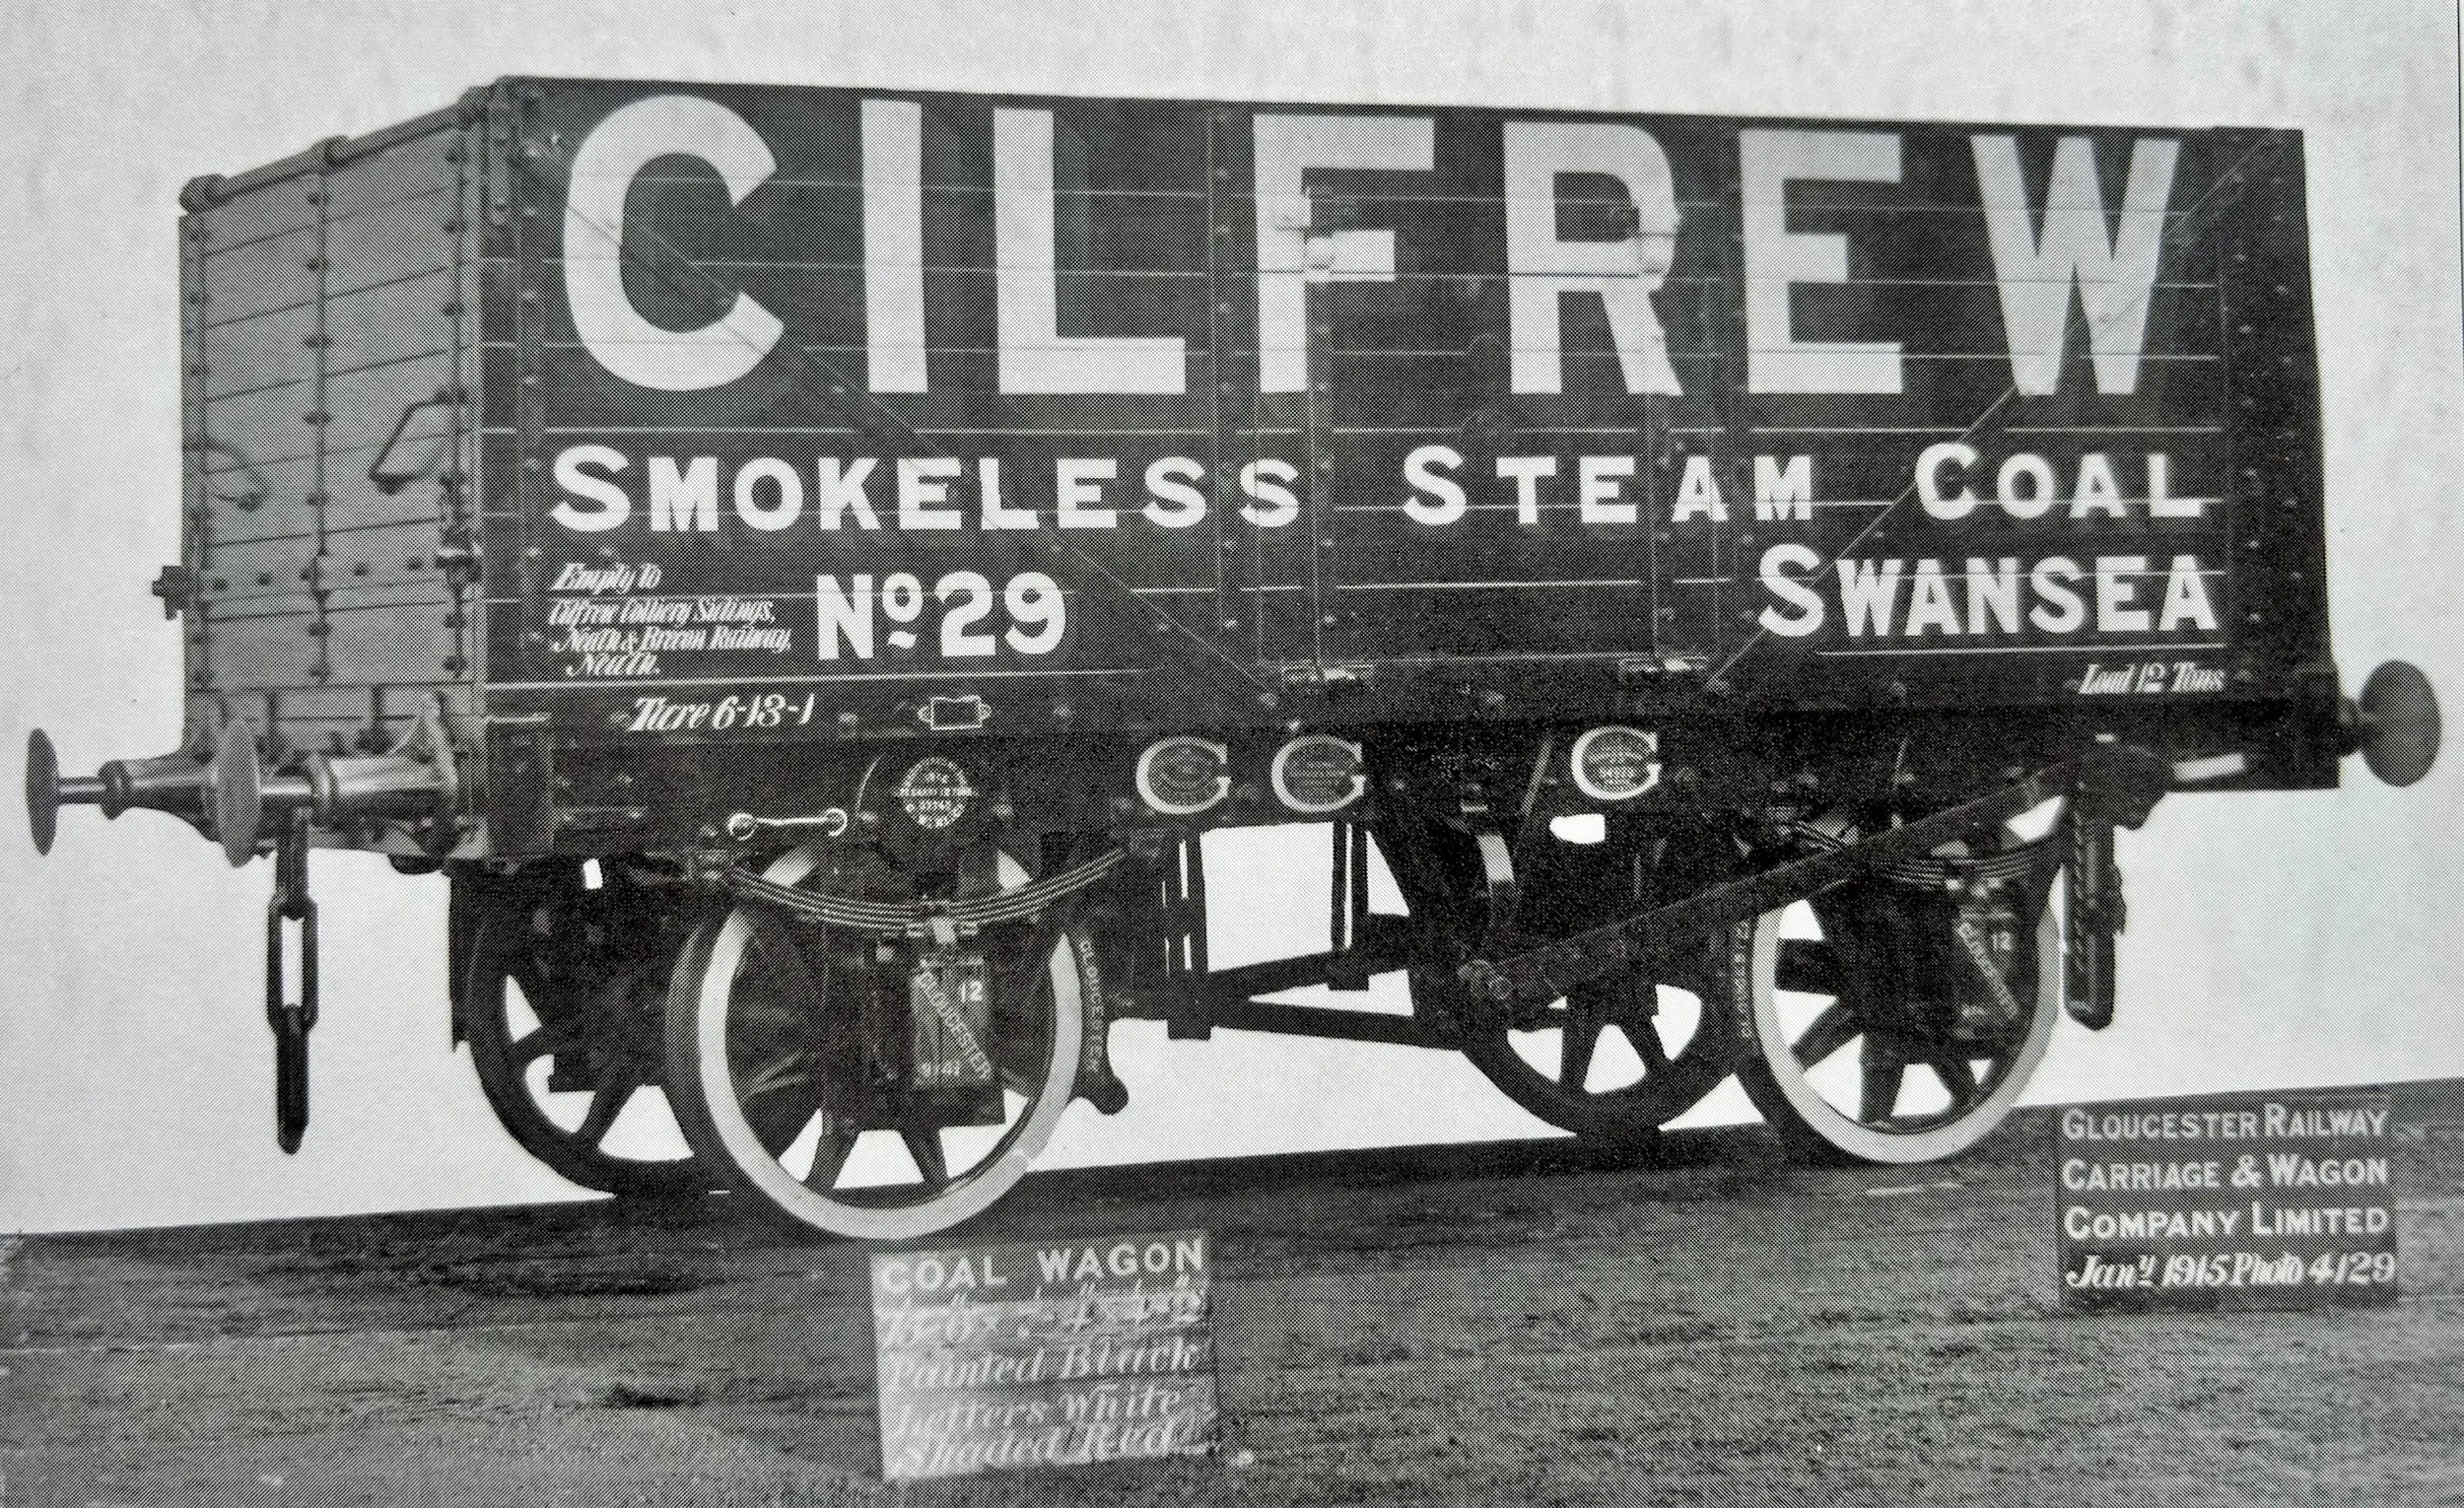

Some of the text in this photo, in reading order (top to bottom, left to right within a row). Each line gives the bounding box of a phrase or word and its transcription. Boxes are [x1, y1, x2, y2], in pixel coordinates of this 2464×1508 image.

[564, 95, 2180, 396] CILFREW
[551, 443, 2203, 532] SMOKELESS STEAM COAL
[550, 562, 639, 594] Empty
[1758, 544, 2220, 637] SWANSEA
[619, 596, 693, 629] Colliery
[933, 571, 1066, 657] 29
[552, 624, 624, 653] Neath
[621, 631, 640, 655] &
[639, 625, 709, 651] Brecon
[2078, 660, 2226, 695] Load 12 Tons
[628, 692, 816, 732] Tare 6-13-1
[1135, 736, 1232, 815] G
[1270, 735, 1367, 814] G
[1570, 724, 1663, 801] G
[1991, 930, 2013, 952] 12
[958, 980, 984, 1003] 12
[1079, 938, 1105, 1073] GLOUCESTER
[918, 971, 992, 1080] GLOUCESTER
[2061, 1102, 2391, 1140] GLOUCESTER RAILWAY
[2061, 1152, 2389, 1191] CARRIAGE & WAGON
[2064, 1200, 2391, 1241] COMPANY LIMITED
[879, 1237, 1204, 1295] COAL WAGON
[2161, 1252, 2230, 1287] 1915
[2228, 1251, 2303, 1286] Photo
[2307, 1250, 2397, 1284] 4129
[887, 1336, 1200, 1393] Painted Black
[893, 1398, 1050, 1440] Letters
[890, 1425, 1061, 1476] Shaded
